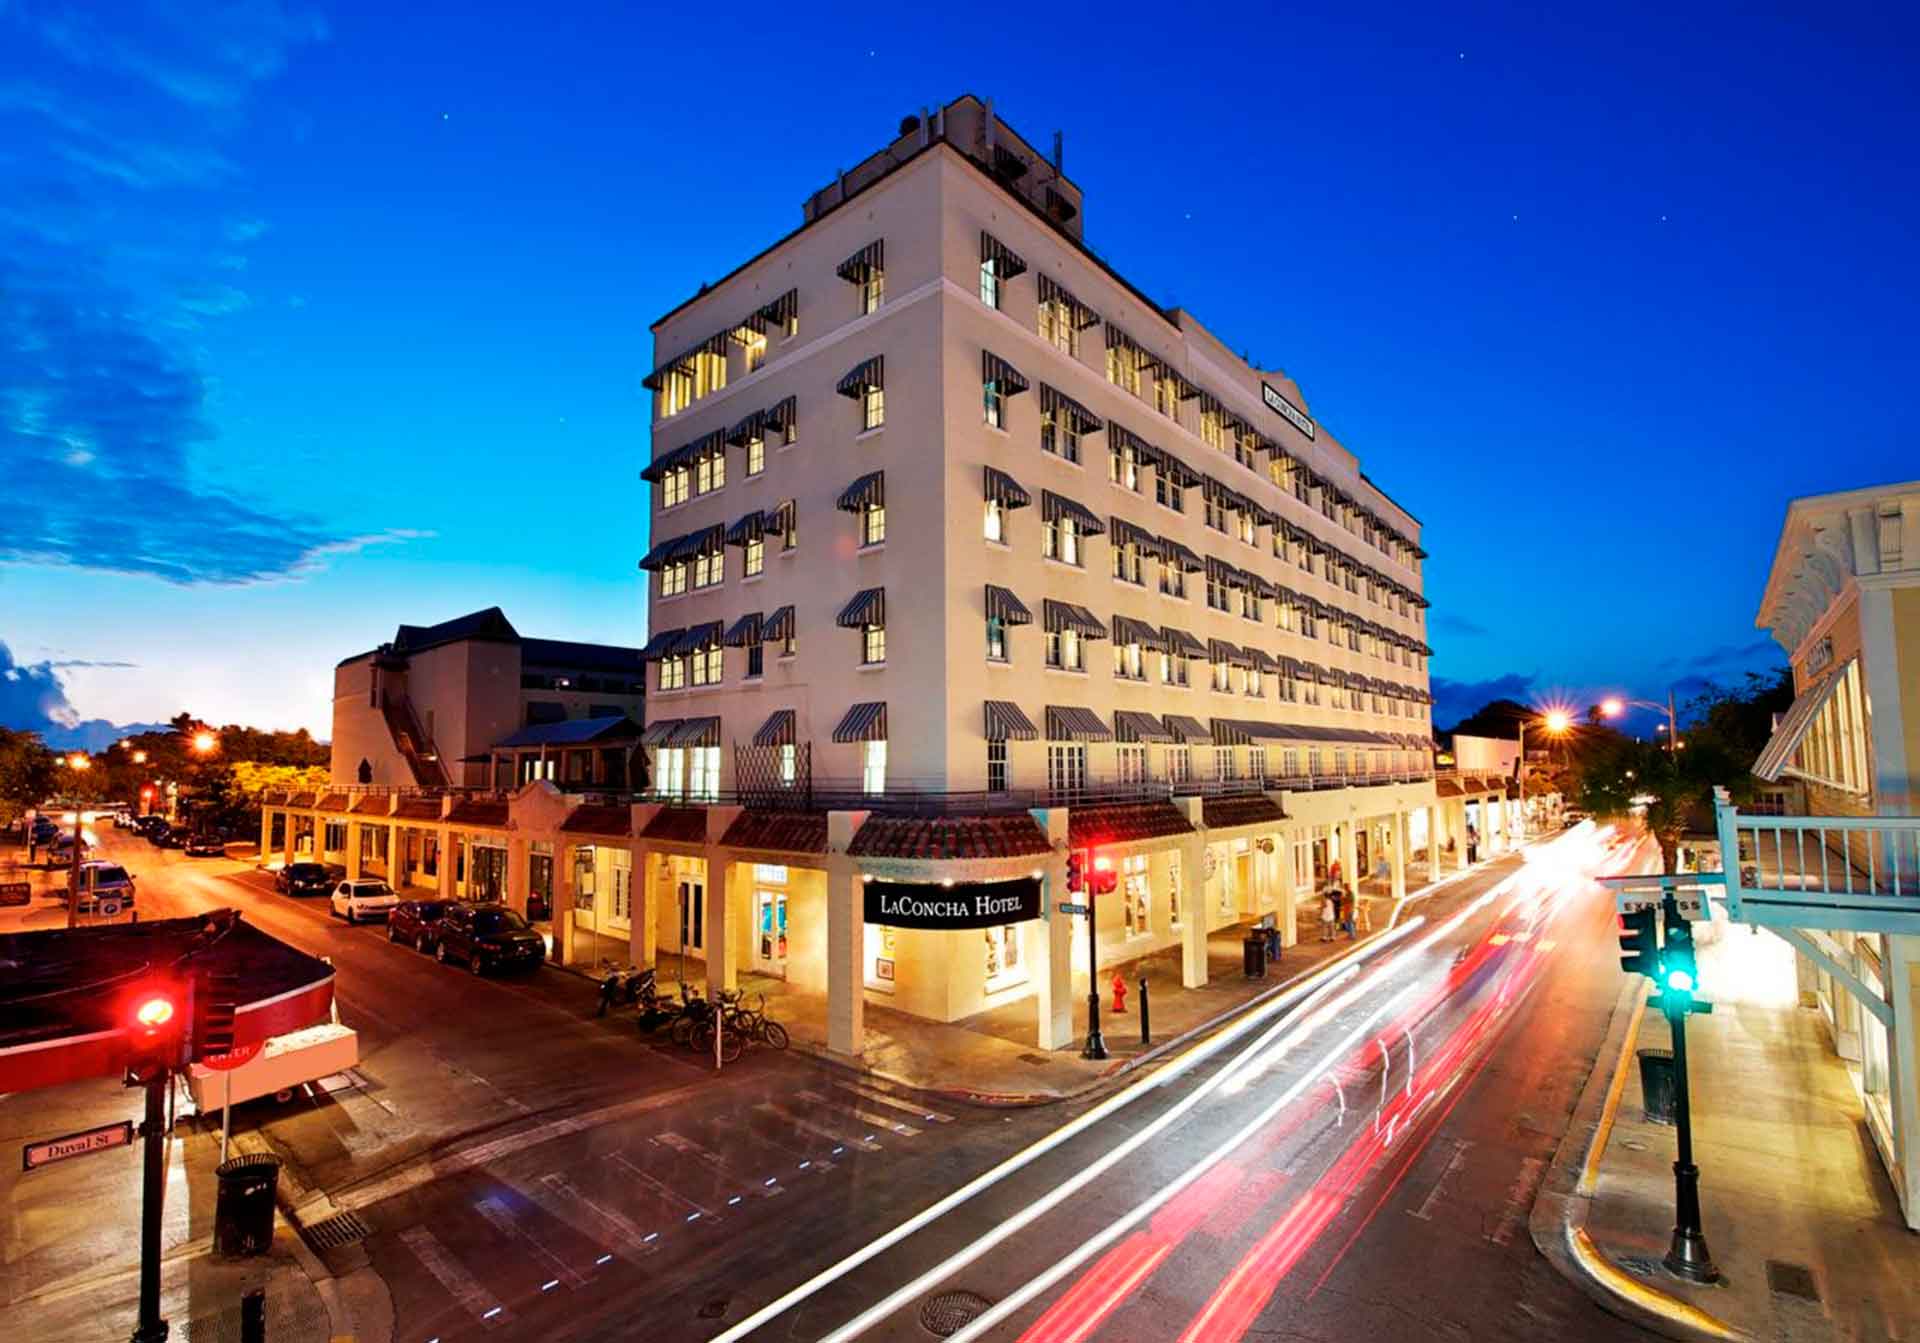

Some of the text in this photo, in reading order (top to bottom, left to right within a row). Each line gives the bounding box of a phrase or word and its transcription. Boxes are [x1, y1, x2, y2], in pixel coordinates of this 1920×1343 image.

[1624, 901, 1701, 911] EXPRSS
[48, 1134, 109, 1158] Duval St
